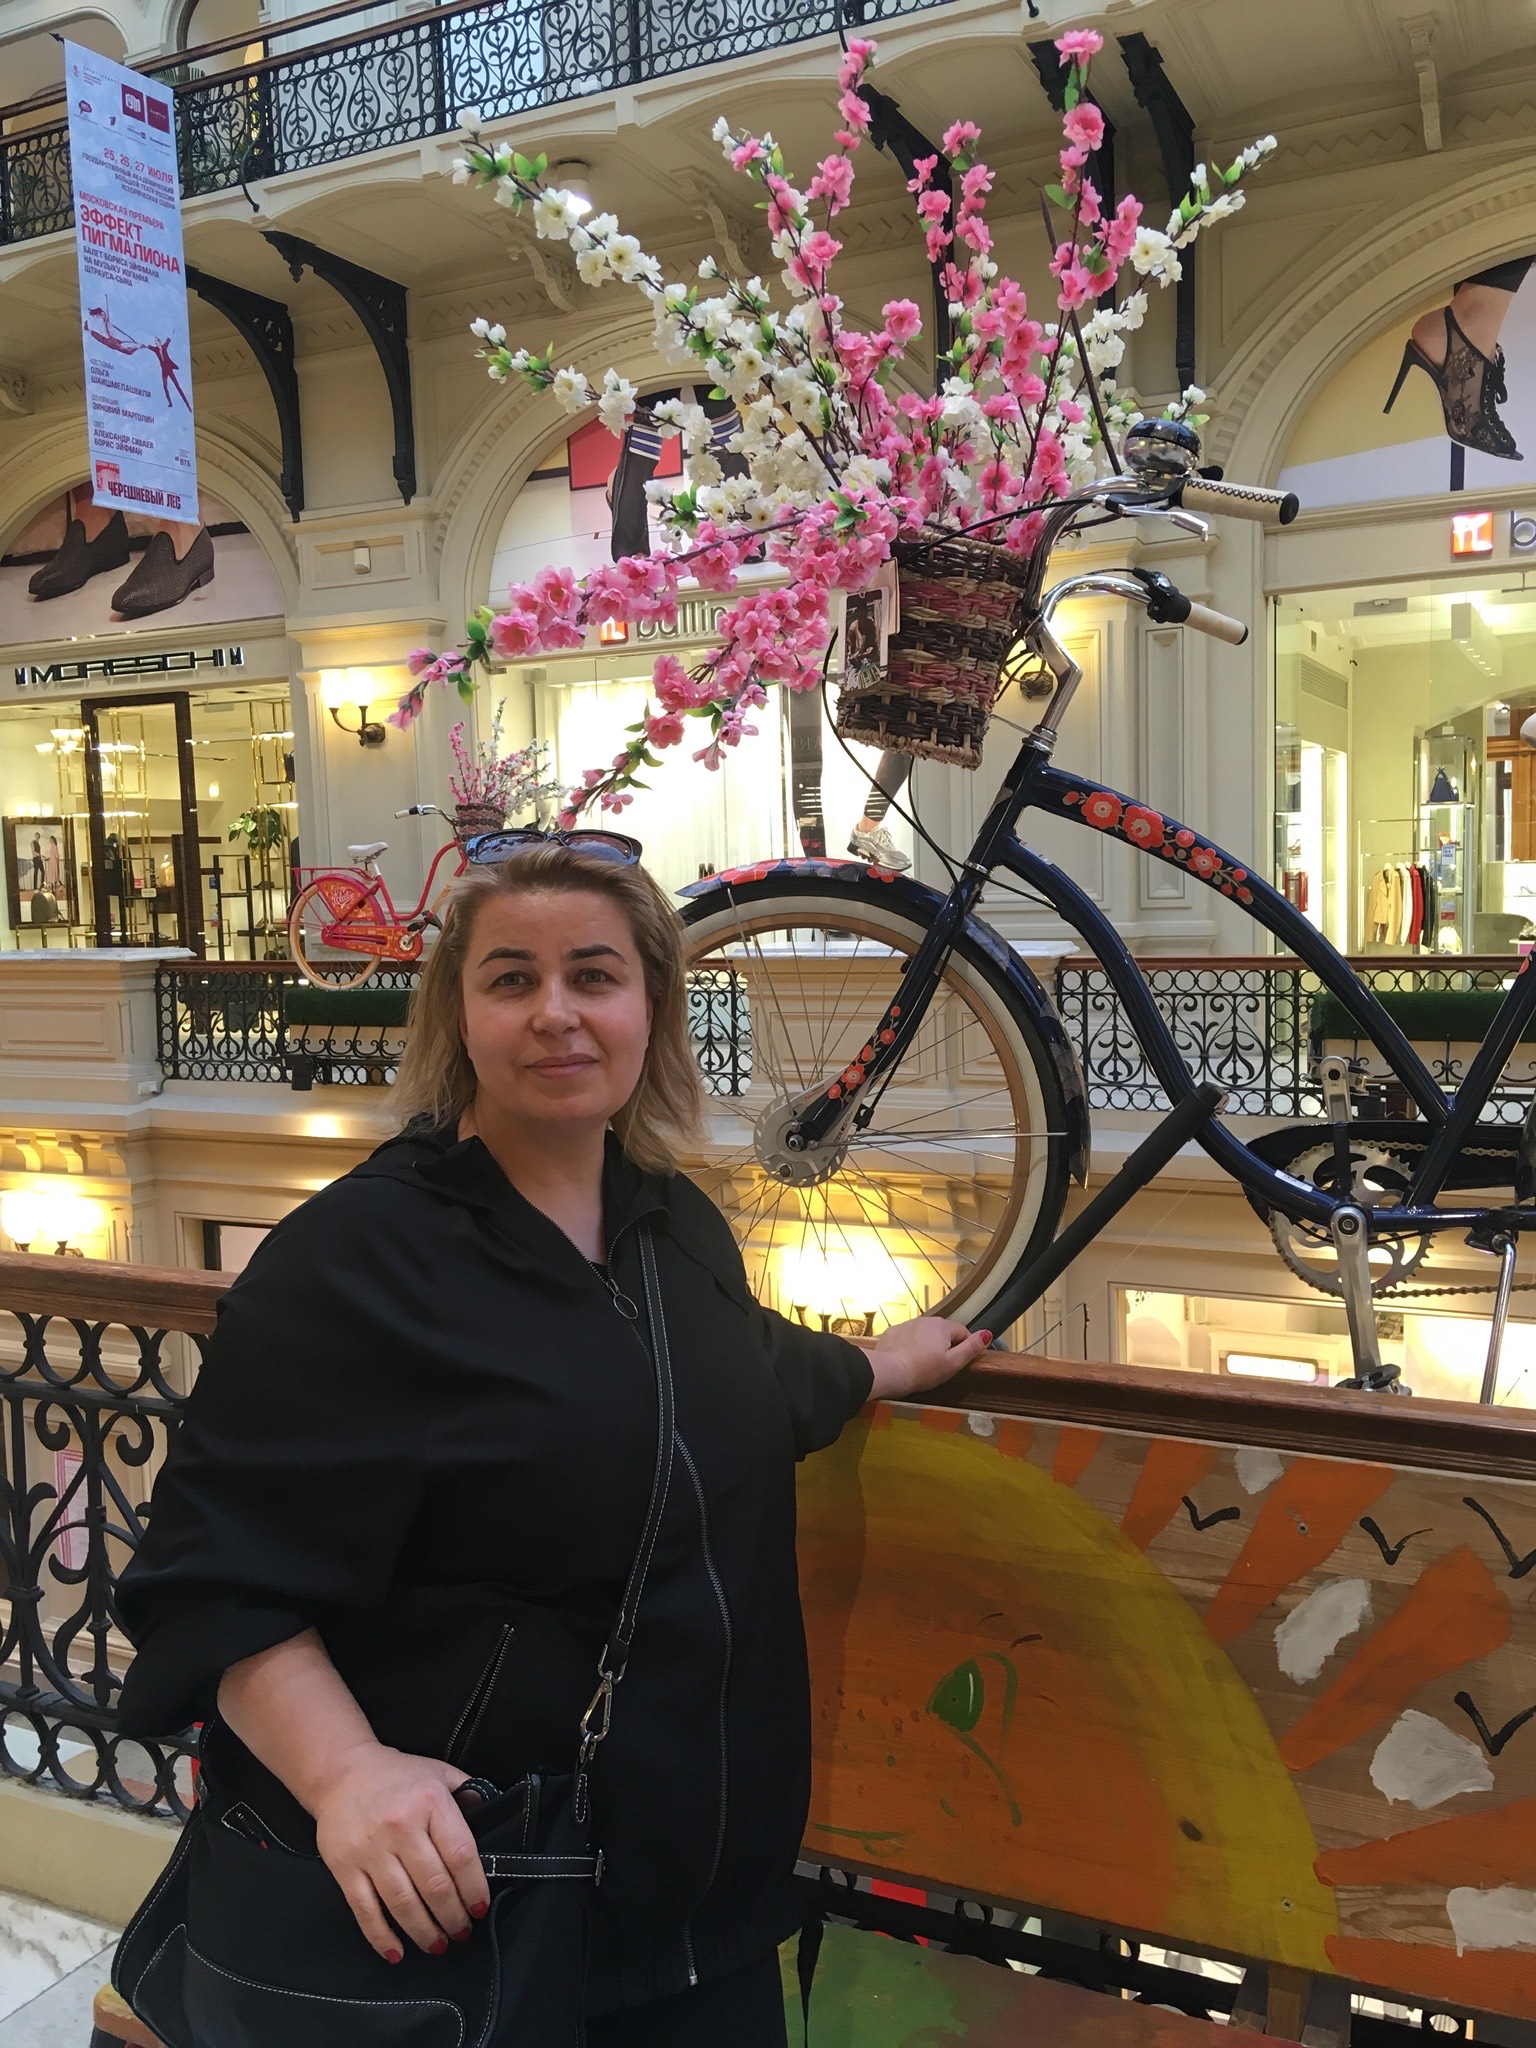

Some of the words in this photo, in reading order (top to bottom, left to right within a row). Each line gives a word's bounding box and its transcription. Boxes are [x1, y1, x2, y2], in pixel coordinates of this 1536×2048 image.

[82, 152, 131, 177] ГОСУДАРСТВЕННЫЙ
[135, 161, 145, 172] 27
[148, 165, 174, 185] ИЮЛЯ
[115, 173, 140, 188] БОЛЬШОЙ
[141, 184, 155, 194] ТЕАТР
[79, 191, 128, 215] МОСКОВСКАЯ
[128, 209, 164, 230] ПРЕМЬЕРА
[80, 204, 143, 241] ЭФФЕКТ
[82, 223, 180, 274] ПИГМАЛИОНА
[83, 245, 103, 258] БАЛЕТ
[104, 253, 128, 267] БОРИСА
[129, 261, 159, 278] ЭЙФМАНА
[83, 255, 93, 264] НА
[93, 259, 120, 273] МУЗЫКУ
[122, 268, 149, 283] ИОГАННА
[84, 264, 133, 287] ШТРАУСА-СЫНА
[90, 366, 110, 378] ОЛЬГА
[92, 402, 121, 415] ЗИНОВИЙ
[121, 409, 155, 424] МАРГОЛИН
[94, 429, 130, 444] АЛЕКСАНДР
[131, 437, 154, 449] СИВАЕВ
[94, 438, 114, 449] БОРИС
[115, 442, 143, 456] ЭЙФМАН
[180, 458, 191, 468] ВТБ
[107, 480, 164, 506] ЧЕРЕШНЕВЫЙ
[166, 493, 181, 510] ЛЕС
[32, 649, 224, 682] MORESCHI
